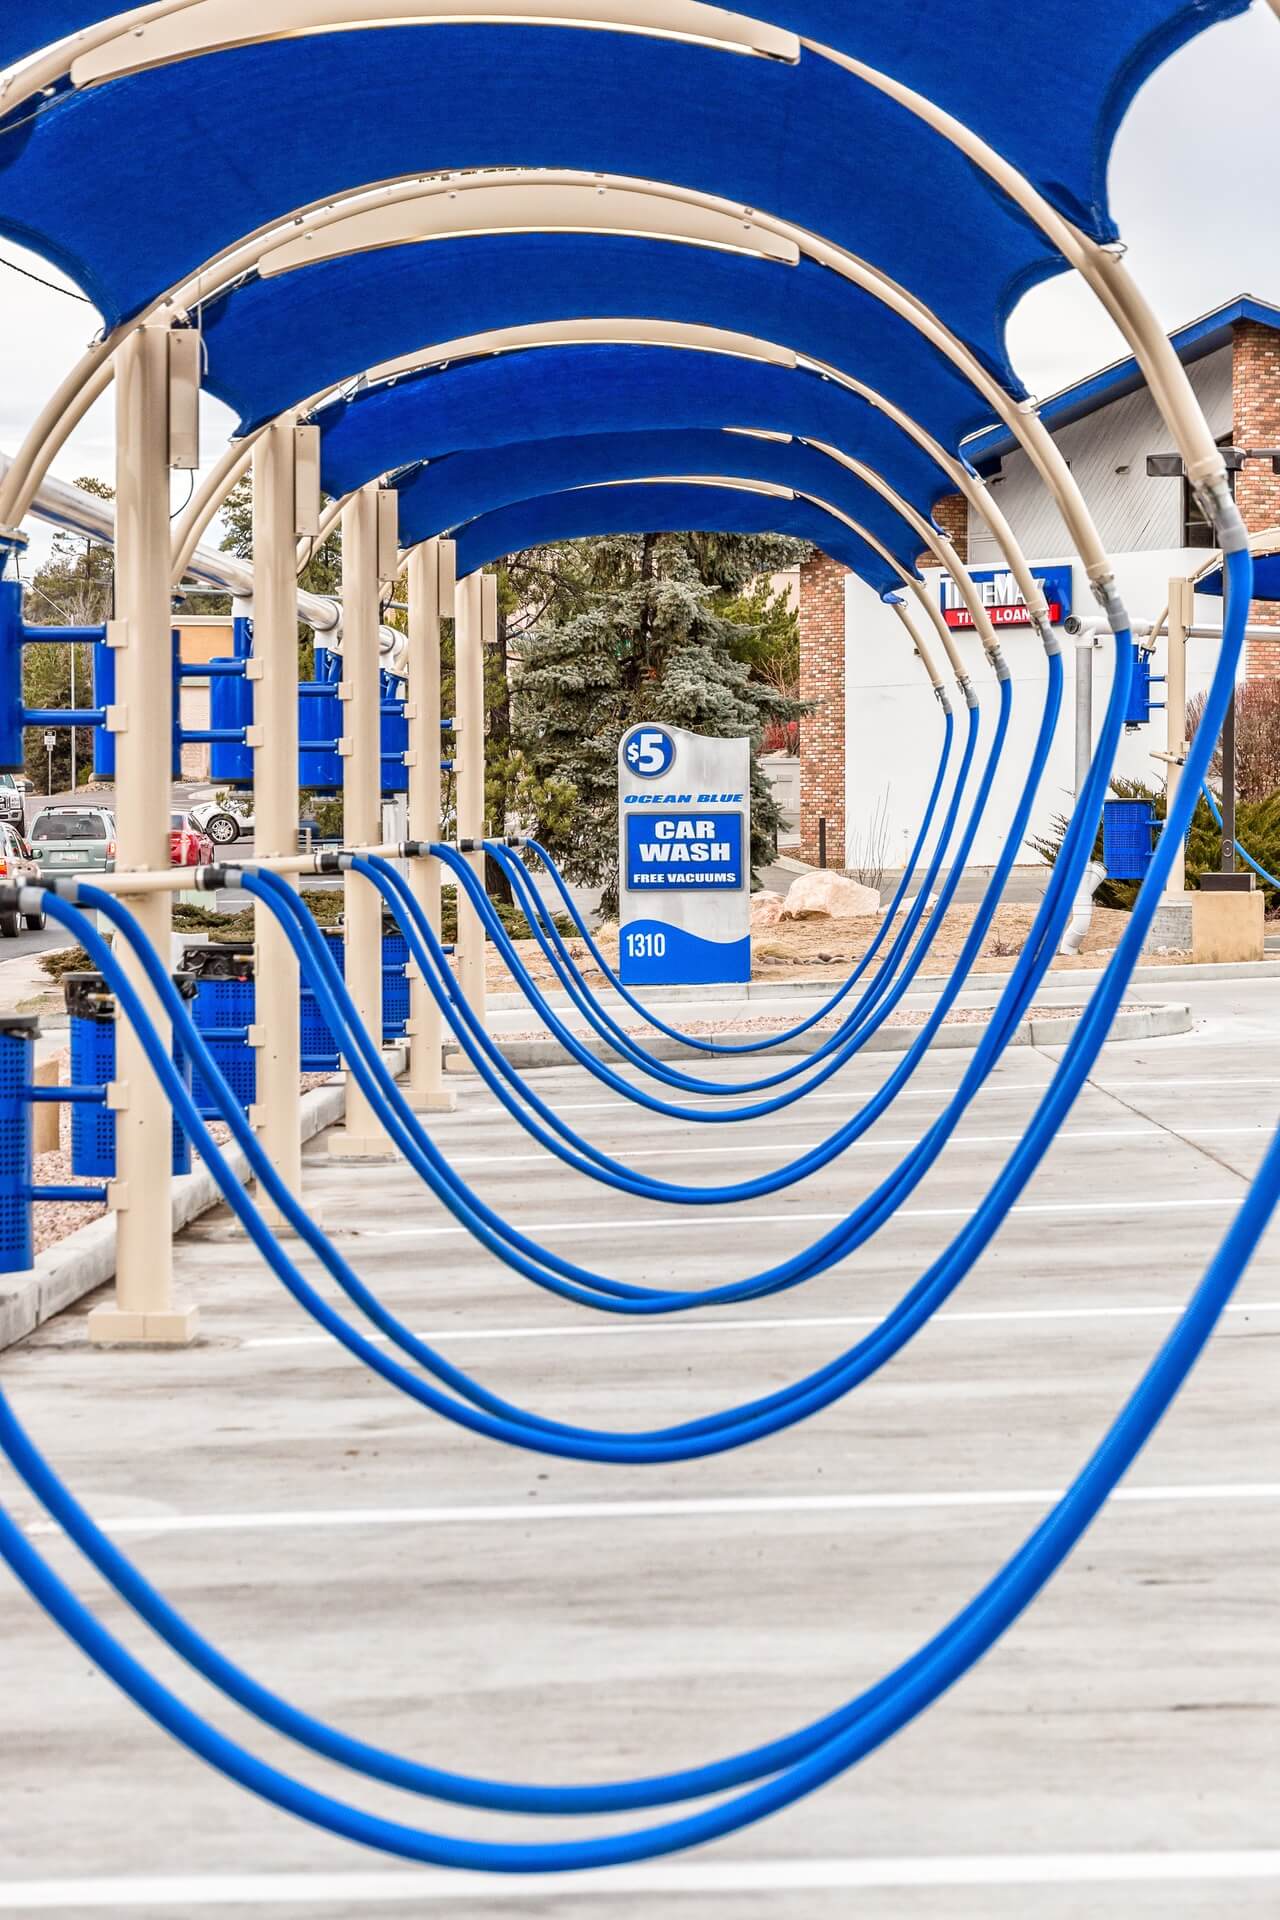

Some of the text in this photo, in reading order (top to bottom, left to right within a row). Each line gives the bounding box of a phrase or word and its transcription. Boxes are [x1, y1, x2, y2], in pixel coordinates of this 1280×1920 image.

[996, 609, 1043, 621] LOAN
[627, 733, 665, 772] $5
[624, 793, 744, 804] OCEAN BLUE
[655, 820, 715, 839] CAR
[639, 843, 730, 862] WASH
[633, 872, 736, 883] FREE VACUUMS
[626, 933, 666, 957] 1310
